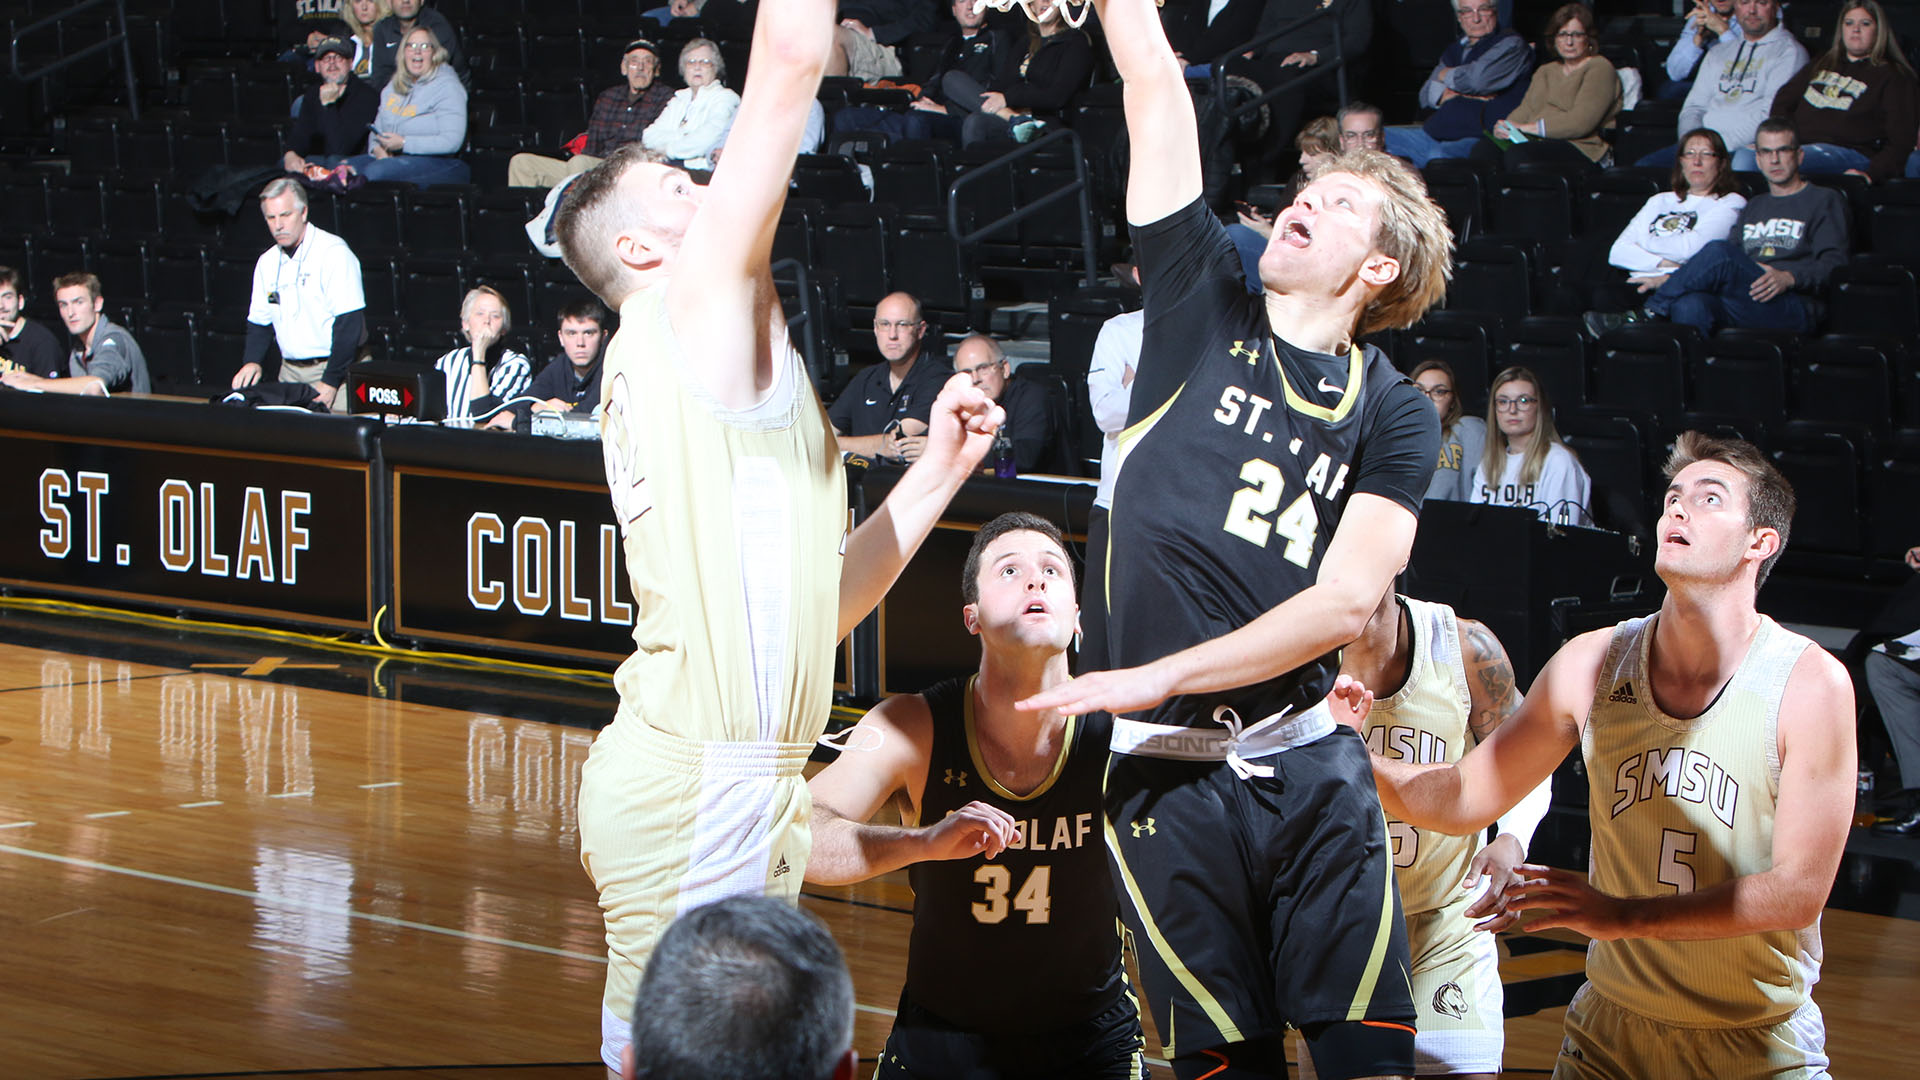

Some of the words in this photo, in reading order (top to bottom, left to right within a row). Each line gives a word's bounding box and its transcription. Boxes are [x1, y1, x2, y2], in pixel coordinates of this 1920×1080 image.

[369, 386, 401, 406] POSS.
[1213, 385, 1273, 443] ST.
[1437, 443, 1463, 471] AF
[1223, 457, 1319, 569] 24
[1504, 484, 1535, 504] OLA
[40, 467, 130, 566] ST.
[159, 478, 311, 585] OLAF
[467, 511, 633, 626] COLL
[1361, 725, 1446, 764] MSU
[1611, 747, 1739, 830] SMSU
[1658, 828, 1697, 895] 5
[971, 864, 1051, 924] 34
